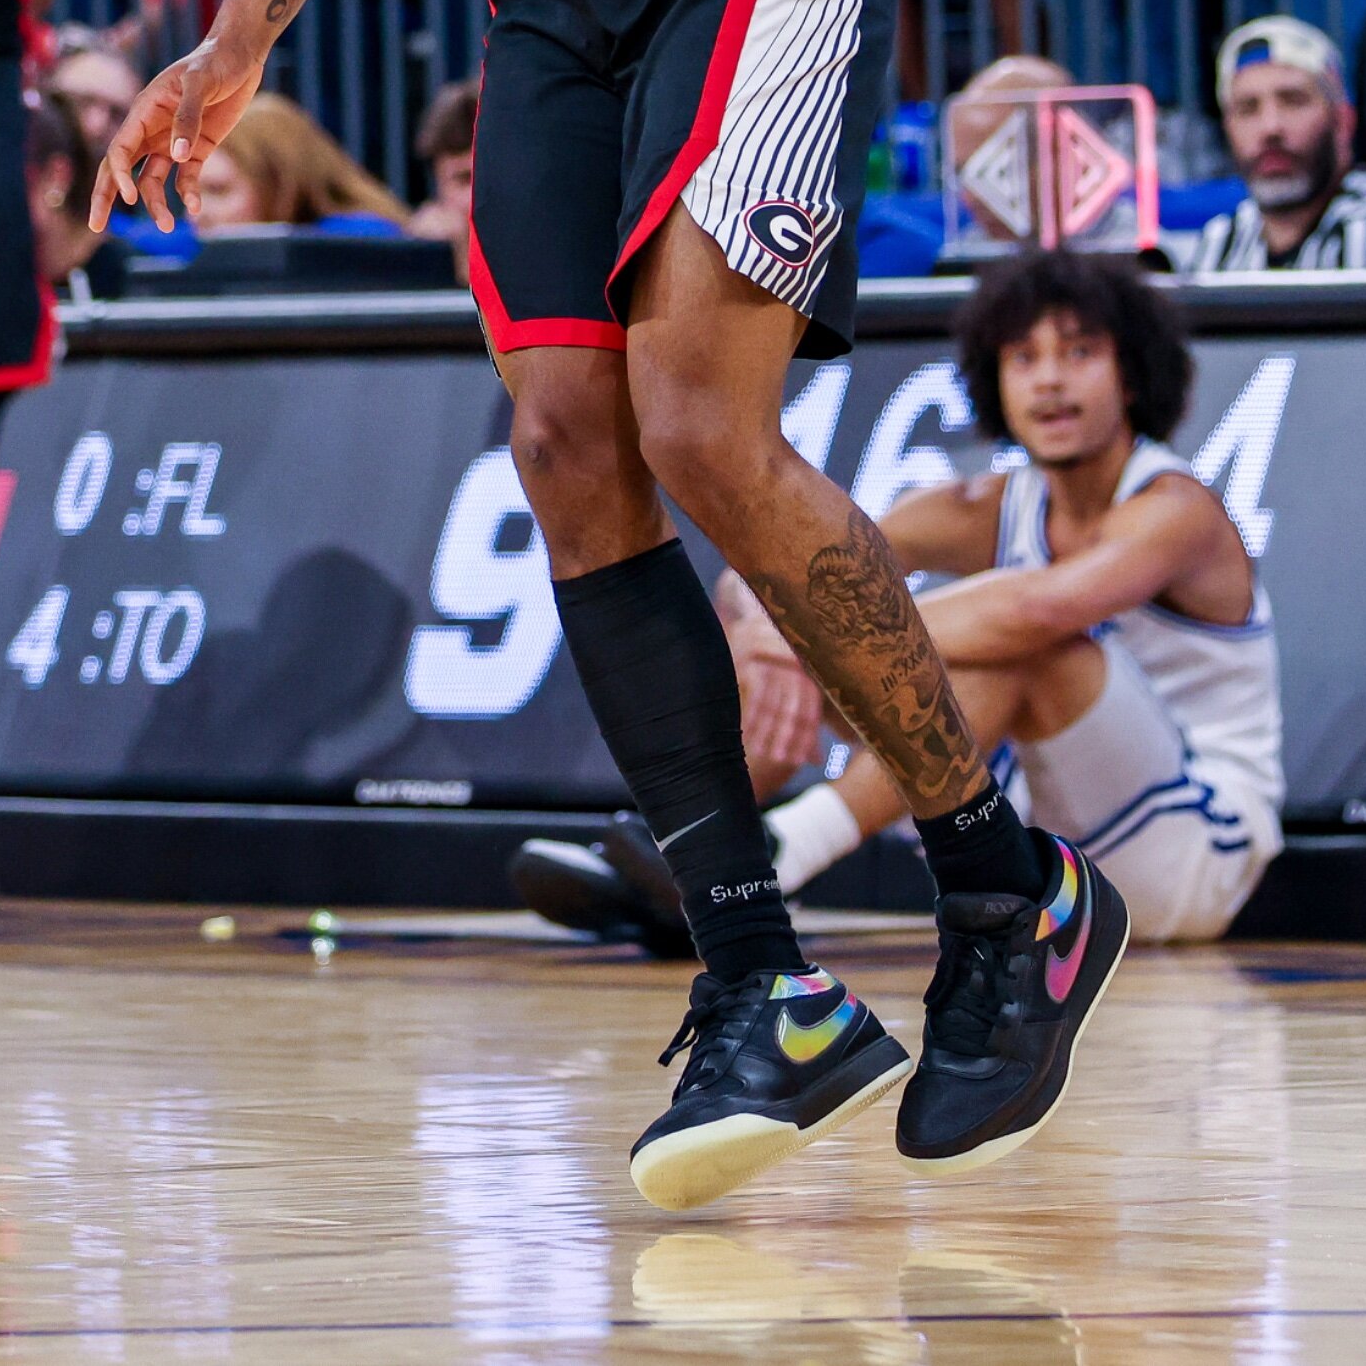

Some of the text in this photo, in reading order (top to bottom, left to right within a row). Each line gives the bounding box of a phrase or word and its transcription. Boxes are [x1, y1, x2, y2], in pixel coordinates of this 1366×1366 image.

[52, 430, 114, 536] 0
[6, 584, 71, 686] 4
[403, 446, 564, 720] 9
